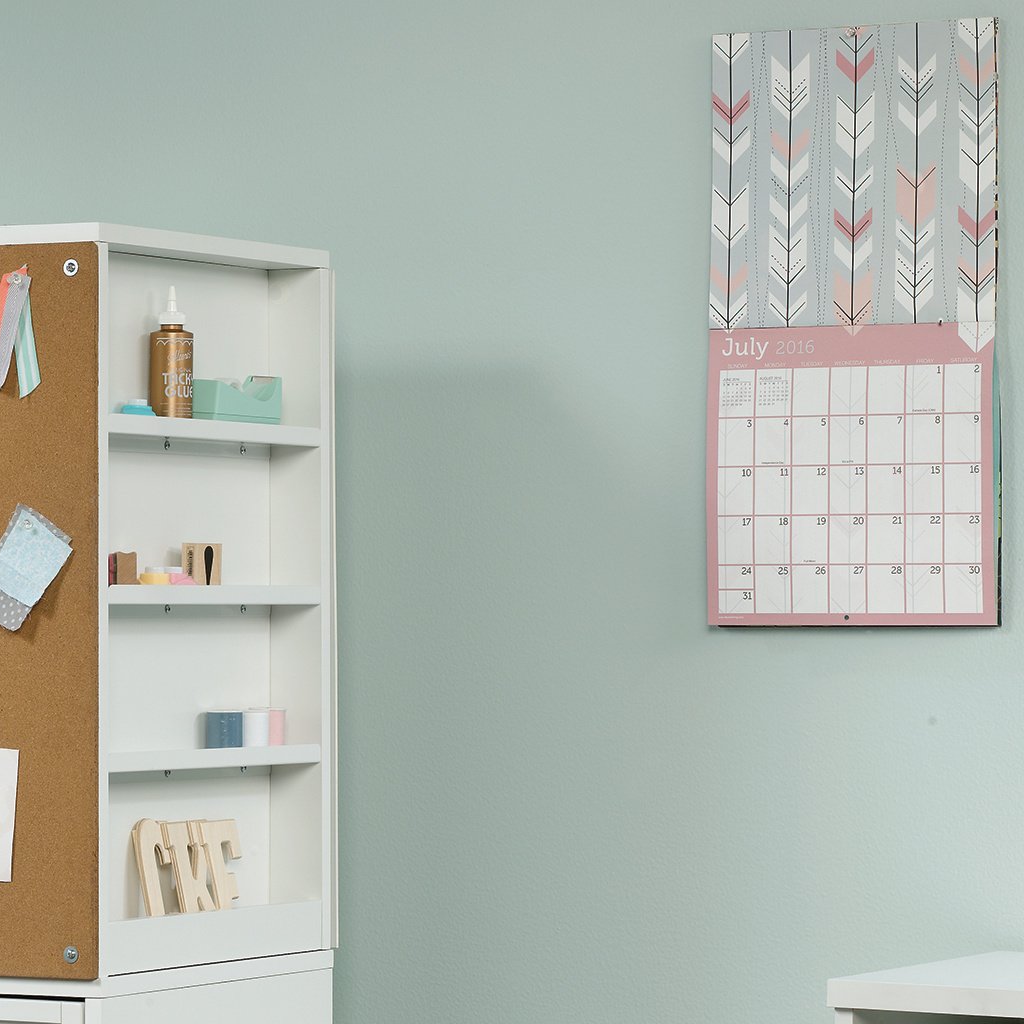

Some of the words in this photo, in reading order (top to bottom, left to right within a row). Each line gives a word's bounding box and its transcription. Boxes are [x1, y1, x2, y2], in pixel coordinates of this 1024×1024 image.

[722, 337, 769, 360] July
[775, 340, 815, 355] 2016
[936, 365, 941, 374] 1
[974, 364, 980, 373] 2
[746, 419, 752, 428] 3
[783, 418, 789, 427] 4
[820, 417, 827, 426] 5
[858, 417, 864, 425] 6
[897, 416, 903, 425] 7
[934, 416, 940, 424] 8
[973, 414, 979, 423] 9
[741, 469, 752, 477] 10
[779, 468, 790, 476] 11
[816, 467, 827, 476] 12
[854, 467, 865, 475] 13
[892, 466, 902, 475] 14
[930, 466, 941, 474] 15
[969, 465, 980, 474] 16
[742, 518, 752, 526] 17
[779, 518, 789, 526] 18
[816, 517, 827, 525] 19
[853, 517, 864, 525] 20
[892, 516, 903, 525] 21
[930, 516, 941, 524] 22
[969, 515, 980, 524] 23
[741, 567, 752, 575] 24
[778, 567, 789, 575] 25
[815, 566, 826, 575] 26
[854, 566, 864, 574] 27
[891, 566, 902, 574] 28
[930, 566, 941, 574] 29
[969, 566, 980, 574] 30
[742, 592, 752, 600] 31
